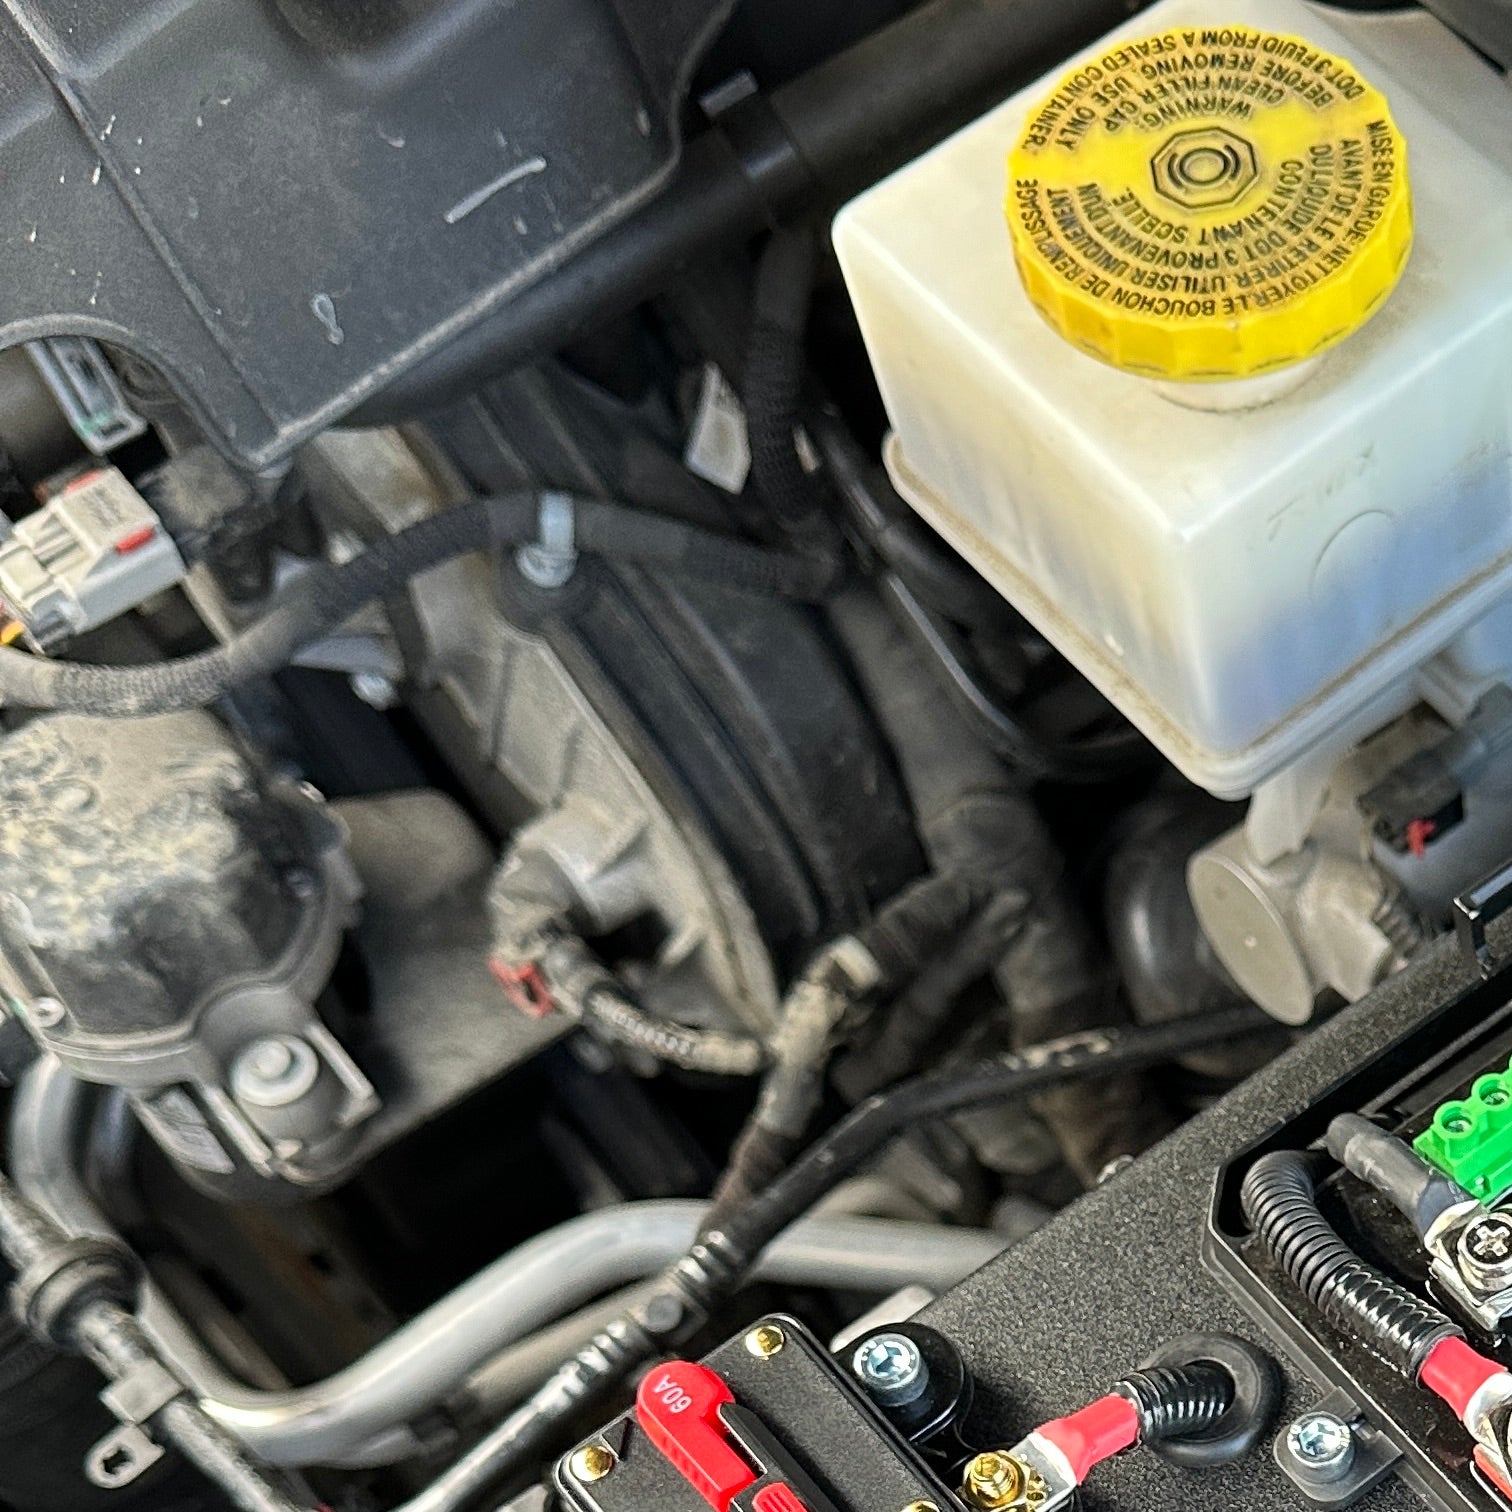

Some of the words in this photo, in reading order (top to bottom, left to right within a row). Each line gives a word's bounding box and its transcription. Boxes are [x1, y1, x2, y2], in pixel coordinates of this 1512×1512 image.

[1102, 35, 1177, 71] SEALED
[1181, 31, 1196, 47] A
[1201, 30, 1261, 50] FROM
[1262, 37, 1319, 67] FLUID
[1313, 58, 1333, 73] 3
[1091, 76, 1134, 107] USE
[1138, 75, 1211, 105] FILLER
[1219, 75, 1285, 102] CLEAN
[1259, 59, 1334, 107] BEFORE
[1324, 69, 1366, 100] DOT
[1022, 66, 1103, 155] CONTAINER.
[1103, 100, 1137, 132] CAP
[1134, 96, 1252, 129] WARNING:
[1055, 106, 1096, 150] ONLY
[1366, 119, 1394, 157] MISE
[1308, 144, 1334, 168] DU
[1340, 139, 1364, 192] AVANT
[1371, 161, 1395, 183] EN
[1199, 160, 1305, 246] CONTENANT
[1281, 170, 1334, 236] LIQUIDE
[1331, 193, 1358, 218] DE
[1047, 188, 1129, 278] UNIQUEMENT
[1093, 218, 1219, 270] PROVENANT
[1314, 217, 1342, 240] LE
[1223, 250, 1239, 266] 3
[1244, 230, 1287, 262] DOT
[1080, 274, 1111, 298] DE
[1130, 267, 1226, 295] UTILISER
[1111, 287, 1216, 317] BOUCHON
[1222, 294, 1249, 315] LE
[652, 1374, 692, 1414] 60A
